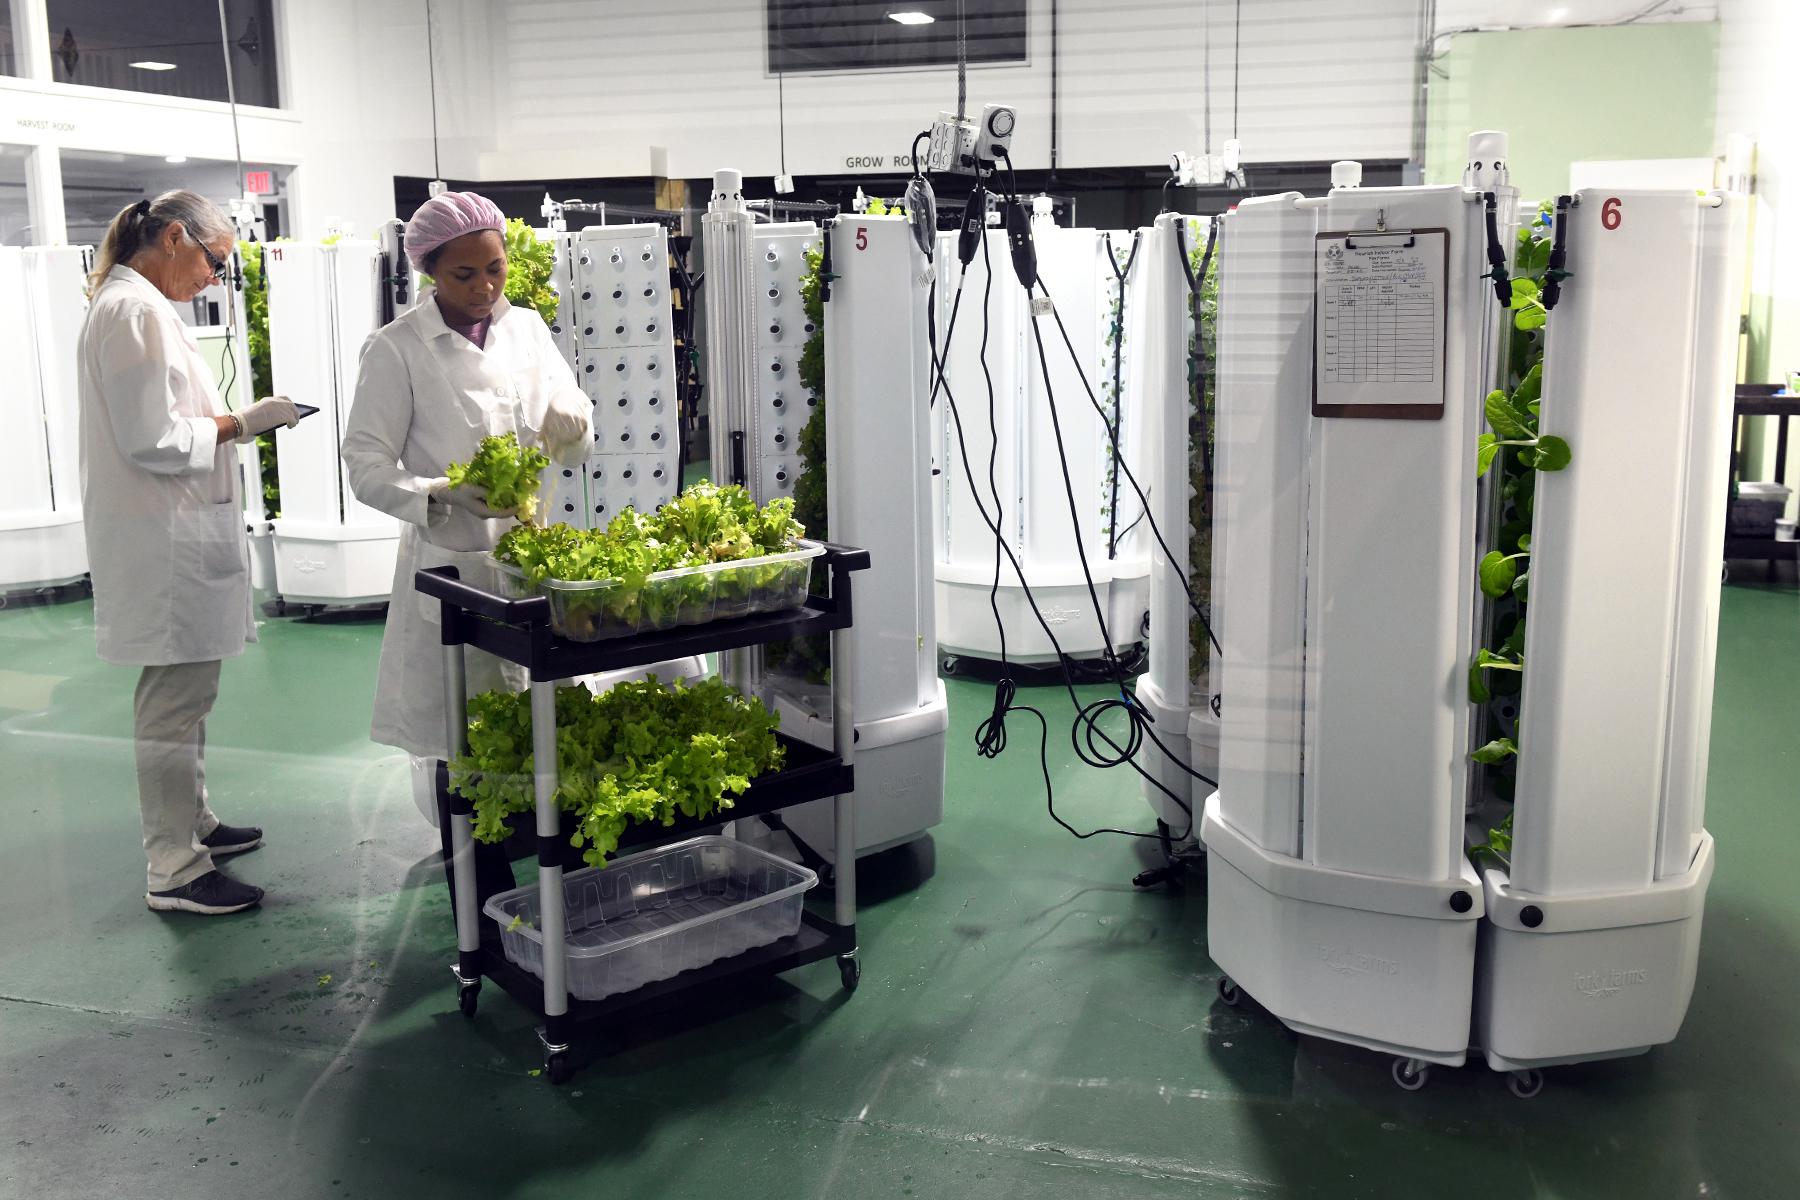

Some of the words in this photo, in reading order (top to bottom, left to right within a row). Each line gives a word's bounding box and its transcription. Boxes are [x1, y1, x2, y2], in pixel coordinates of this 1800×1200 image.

[17, 119, 48, 130] HARVEST
[52, 122, 75, 132] ROOM
[846, 156, 884, 168] GROW
[1601, 197, 1622, 230] 6
[856, 227, 868, 250] 5
[271, 248, 282, 261] 11
